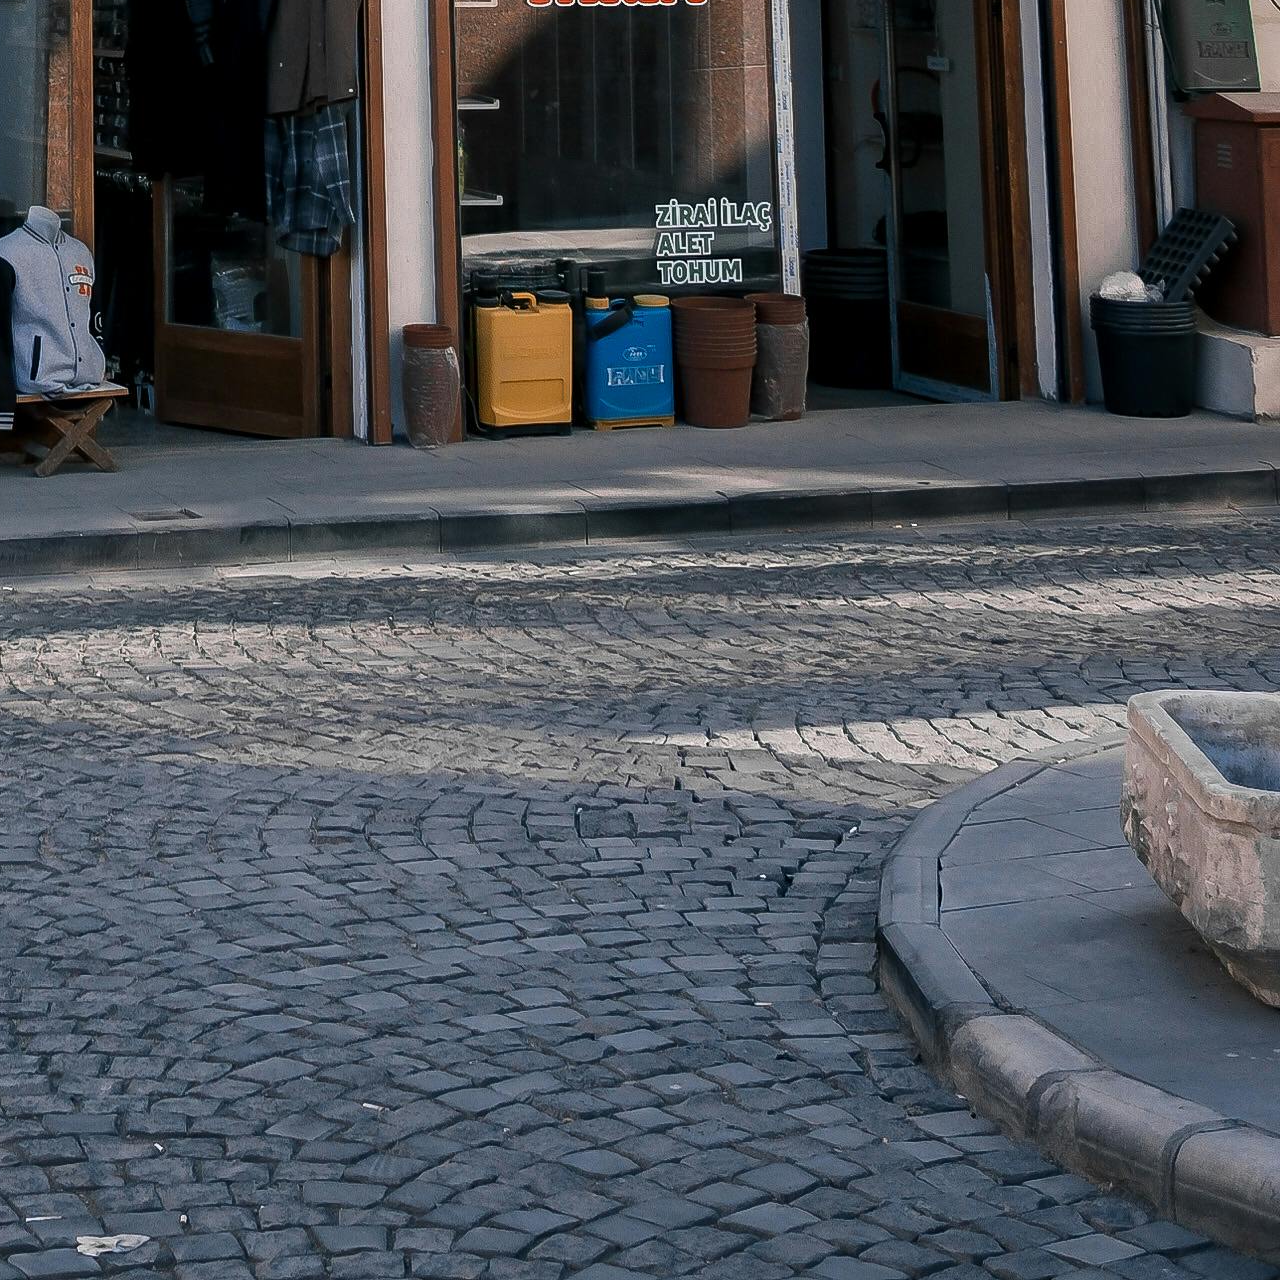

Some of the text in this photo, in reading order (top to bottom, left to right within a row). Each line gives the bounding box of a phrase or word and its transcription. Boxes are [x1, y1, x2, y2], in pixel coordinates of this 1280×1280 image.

[655, 196, 773, 232] ZİRAİ İLAÇ
[656, 231, 715, 257] ALET
[656, 258, 743, 285] TOHUM
